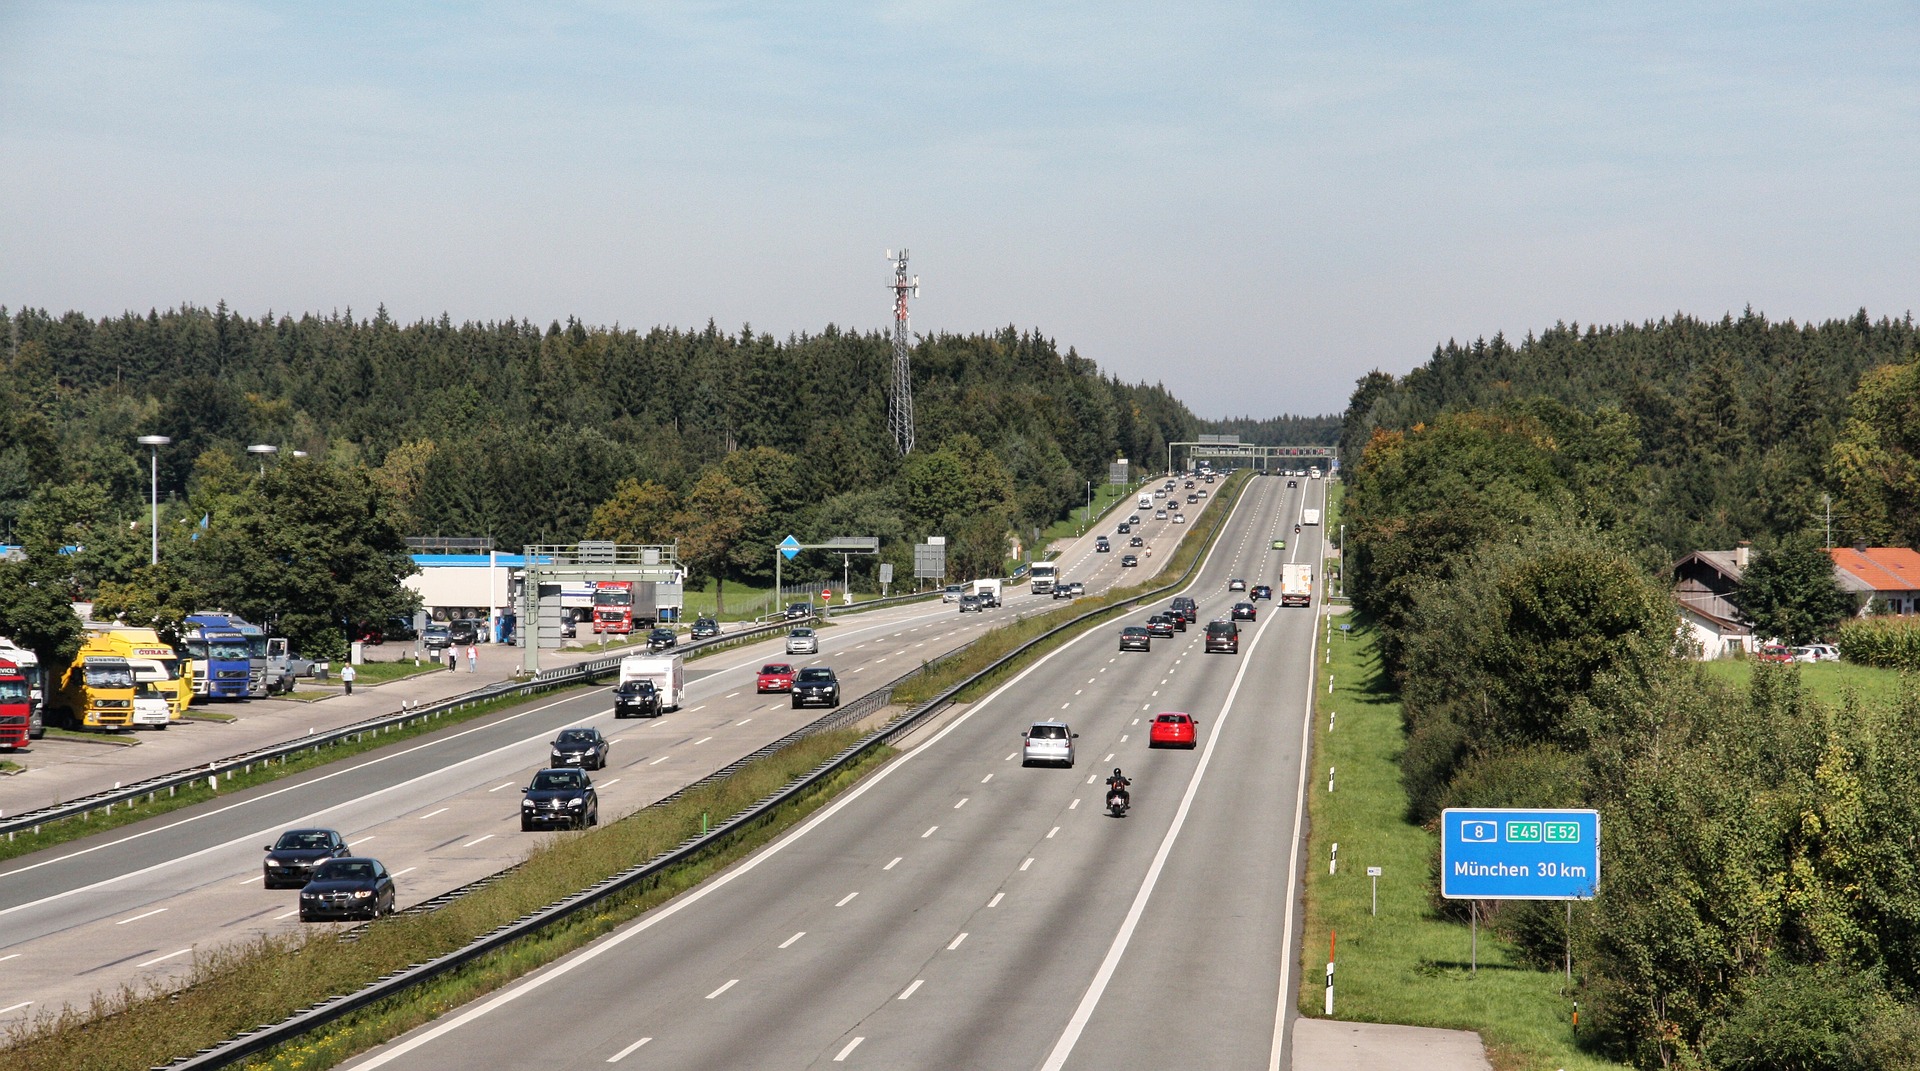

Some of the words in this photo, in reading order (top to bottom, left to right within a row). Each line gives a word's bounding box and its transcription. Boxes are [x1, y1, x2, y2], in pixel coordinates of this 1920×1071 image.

[1474, 825, 1484, 838] 8
[1454, 861, 1529, 877] München
[1537, 862, 1557, 877] 30
[1561, 862, 1586, 877] km
